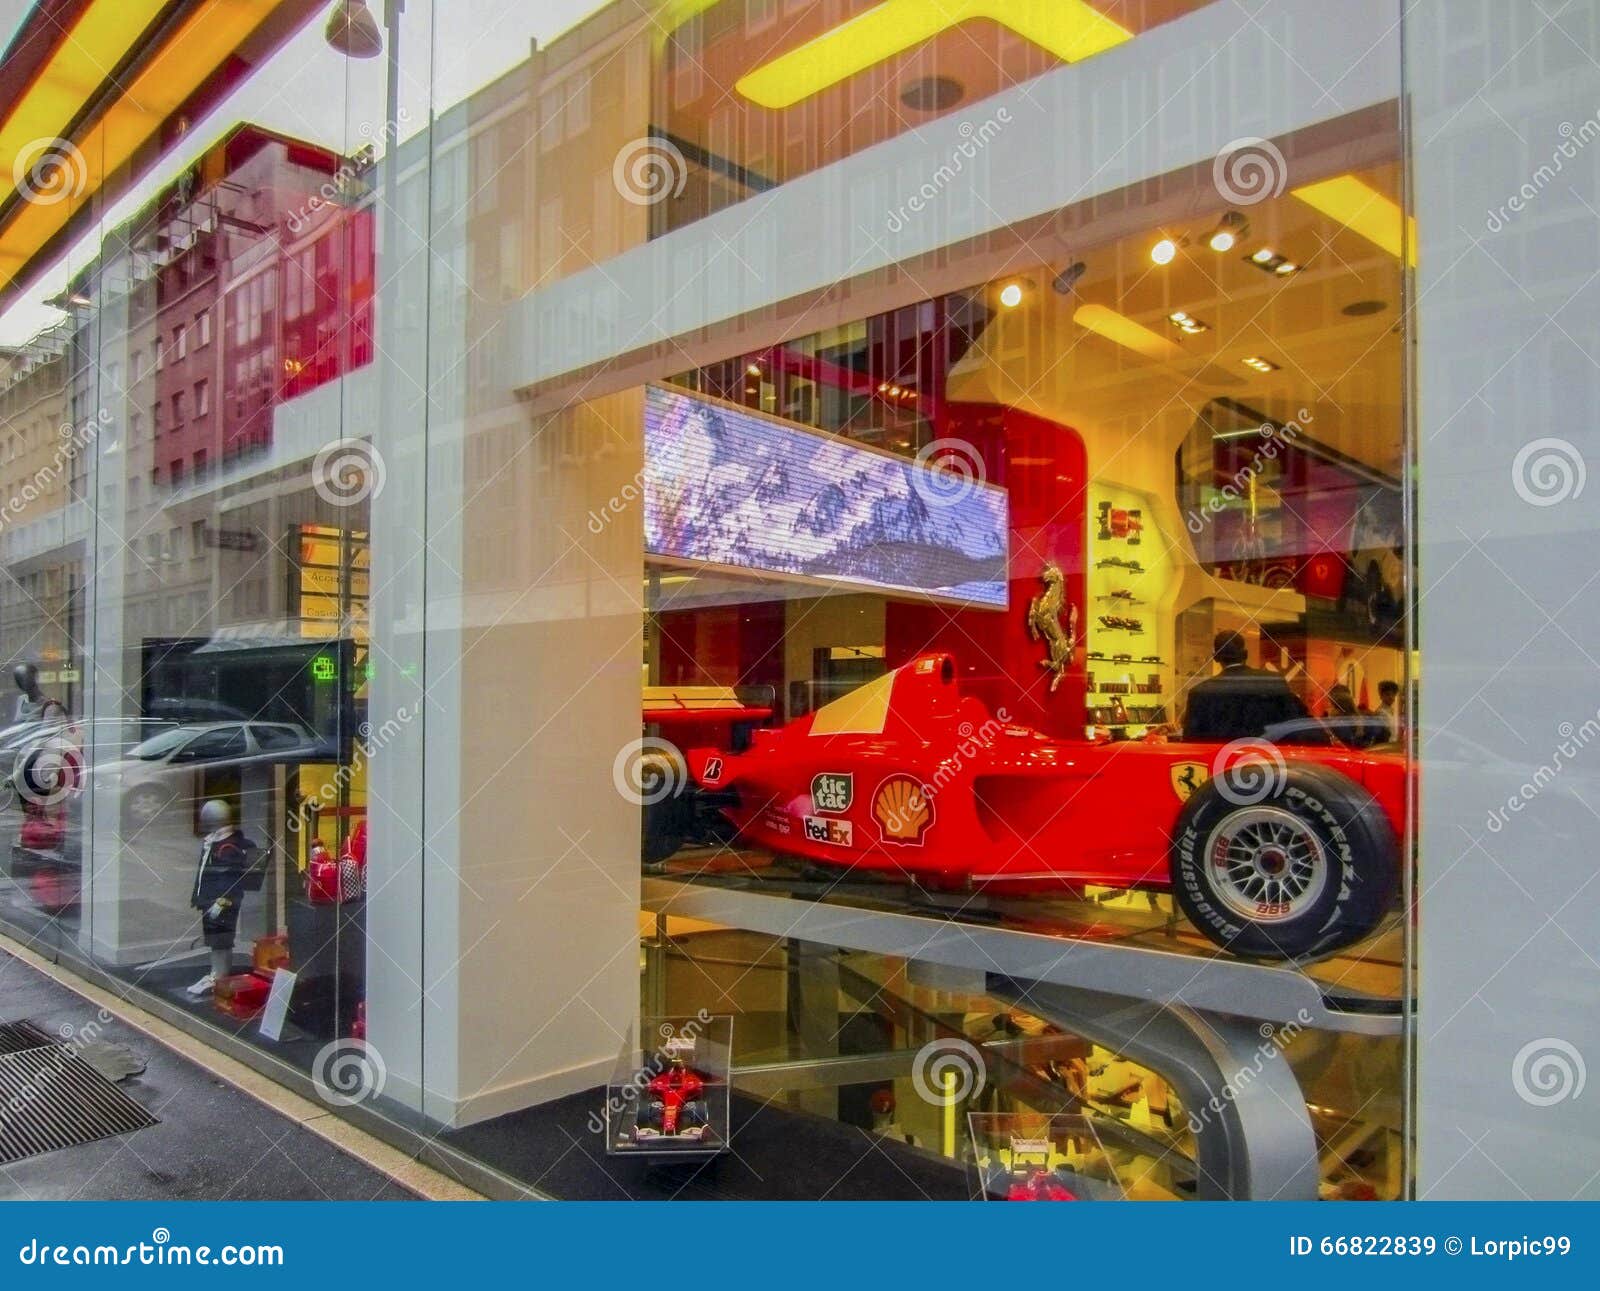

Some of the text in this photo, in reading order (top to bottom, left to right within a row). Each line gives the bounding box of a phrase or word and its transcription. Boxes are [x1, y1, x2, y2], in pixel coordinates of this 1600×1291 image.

[820, 775, 846, 795] tic
[816, 789, 847, 809] tac
[804, 817, 850, 845] FedEx
